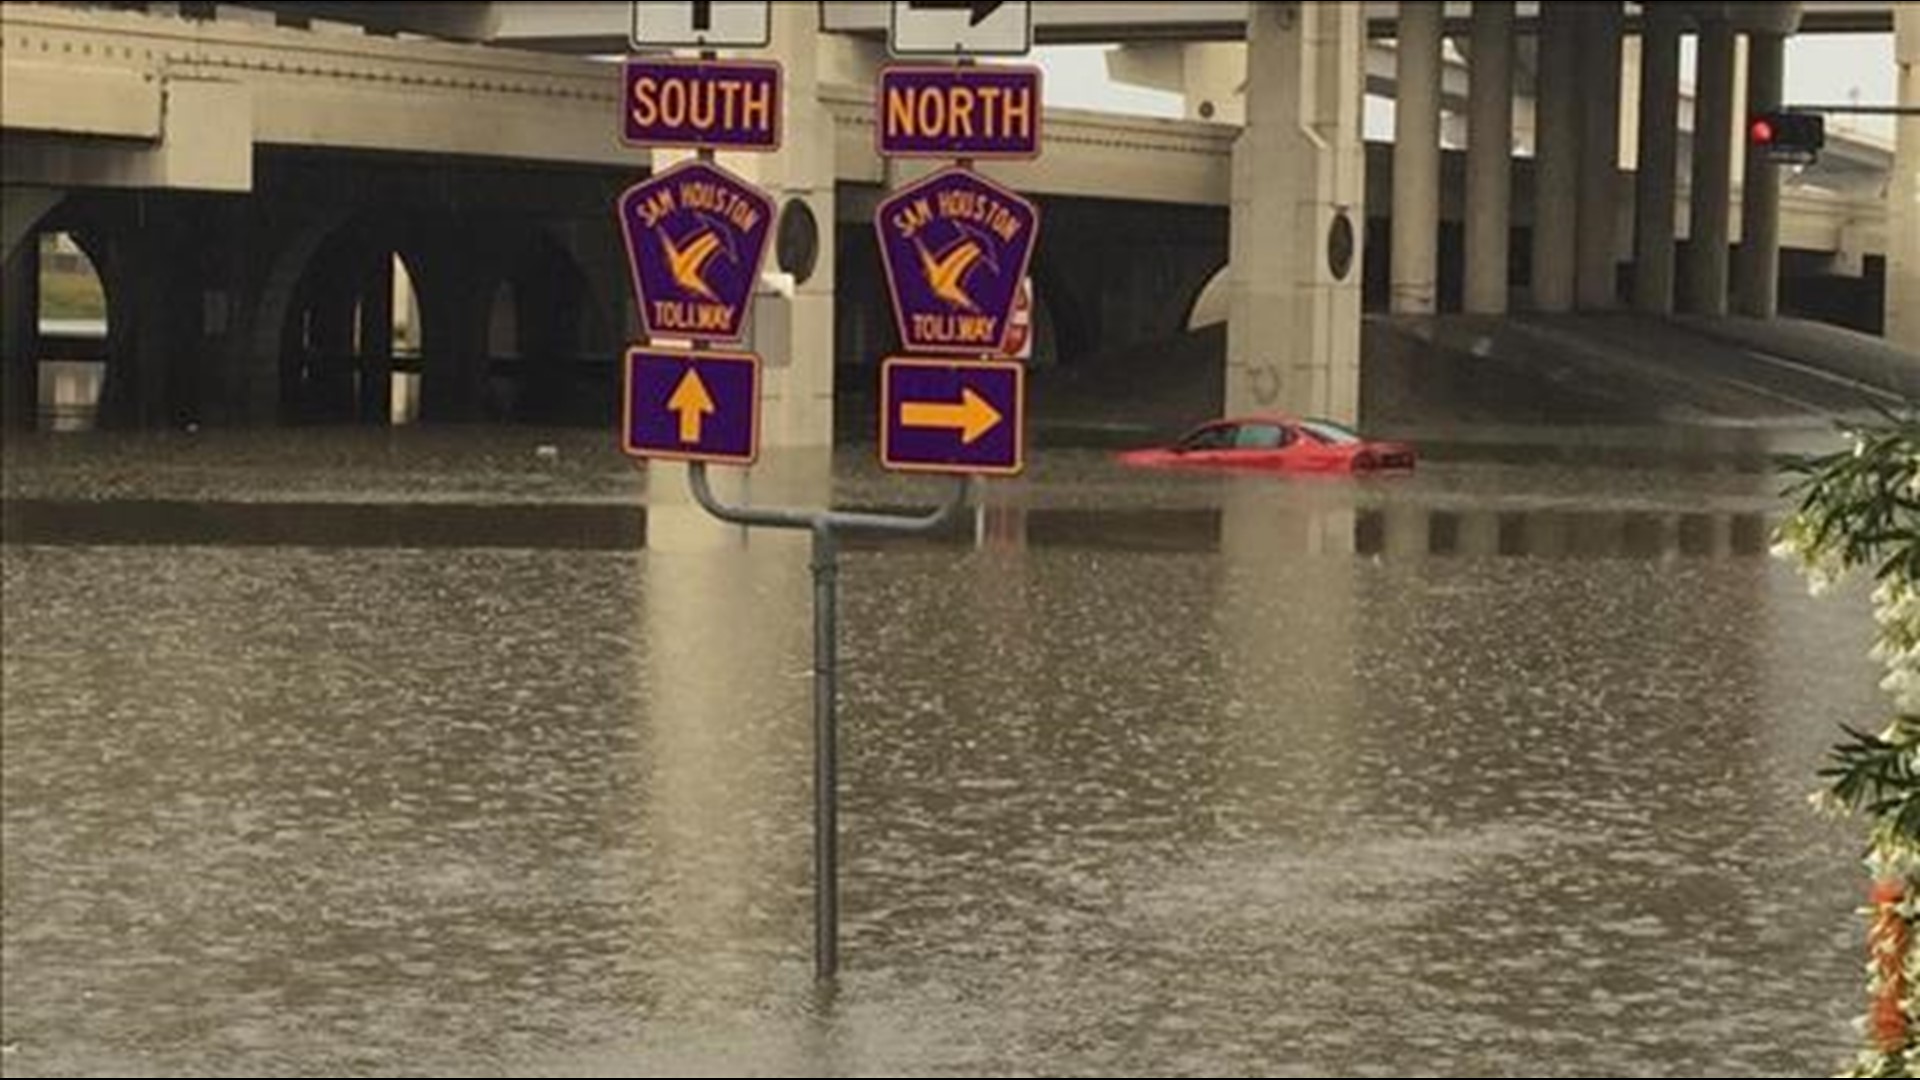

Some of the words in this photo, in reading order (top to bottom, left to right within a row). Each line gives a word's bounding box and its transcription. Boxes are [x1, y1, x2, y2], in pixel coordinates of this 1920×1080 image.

[632, 77, 770, 131] SOUTH
[887, 87, 1030, 138] NORTH
[637, 190, 676, 228] SAM
[680, 182, 759, 231] HOUSTON
[893, 199, 935, 239] SAM
[938, 189, 1022, 242] HOUSTON
[653, 301, 735, 331] TOLLWAY
[911, 313, 999, 342] TOLLWAY
